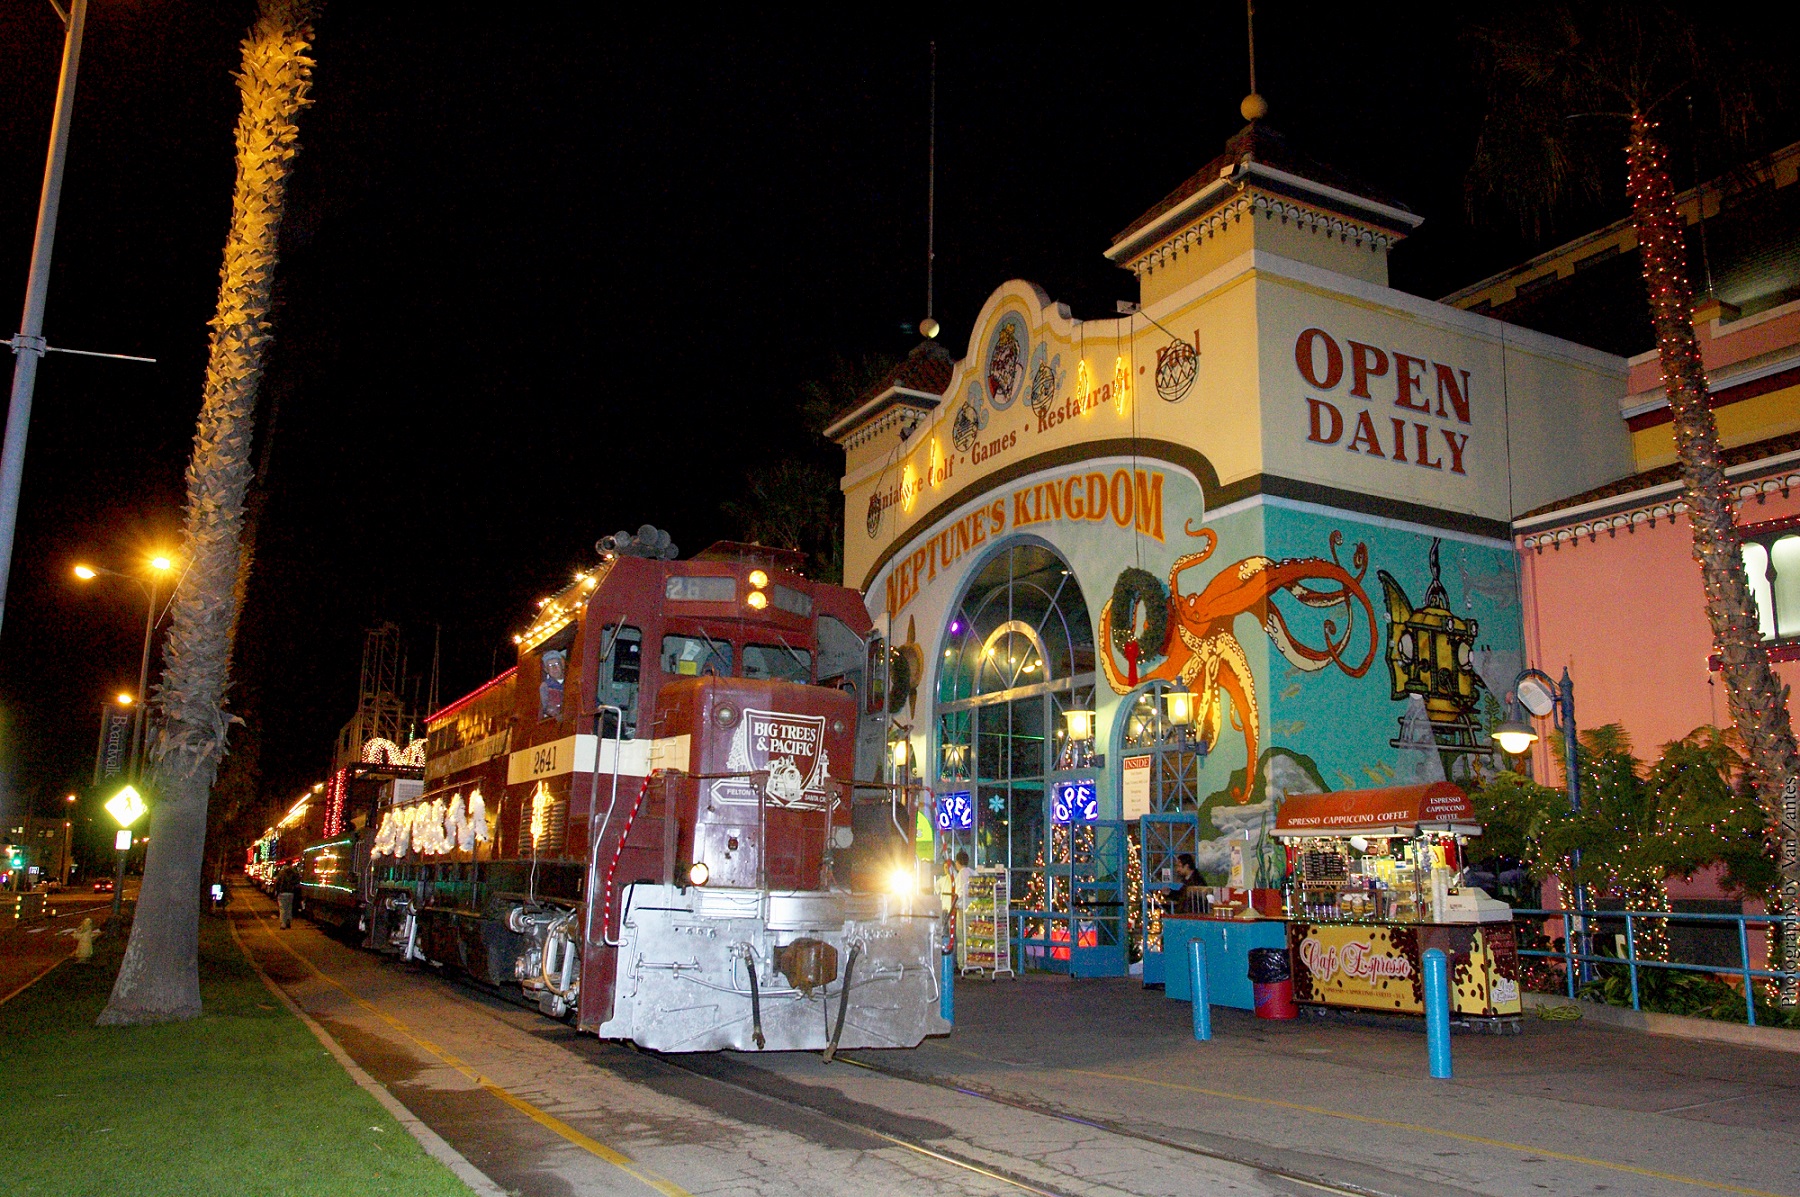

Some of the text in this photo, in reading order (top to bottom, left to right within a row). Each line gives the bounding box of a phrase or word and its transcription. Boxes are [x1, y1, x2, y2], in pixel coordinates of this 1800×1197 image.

[1294, 327, 1471, 424] OPEN
[971, 429, 1017, 466] Games
[1305, 397, 1469, 475] DAILY
[885, 467, 1166, 620] NEPTUNE'S KINGDOM
[754, 721, 816, 742] BIG TREES
[105, 714, 128, 779] Boardwalk
[756, 736, 814, 757] & PACIFIC
[533, 745, 557, 775] 2641
[1125, 758, 1150, 769] INSIDE
[726, 788, 750, 796] FELTON
[1430, 796, 1461, 805] ESPRESSO
[1323, 814, 1375, 825] CAPPUCCINO
[1377, 810, 1410, 821] COFFEE
[1426, 804, 1466, 813] CAPPUCCINO
[1340, 941, 1411, 986] Espresso
